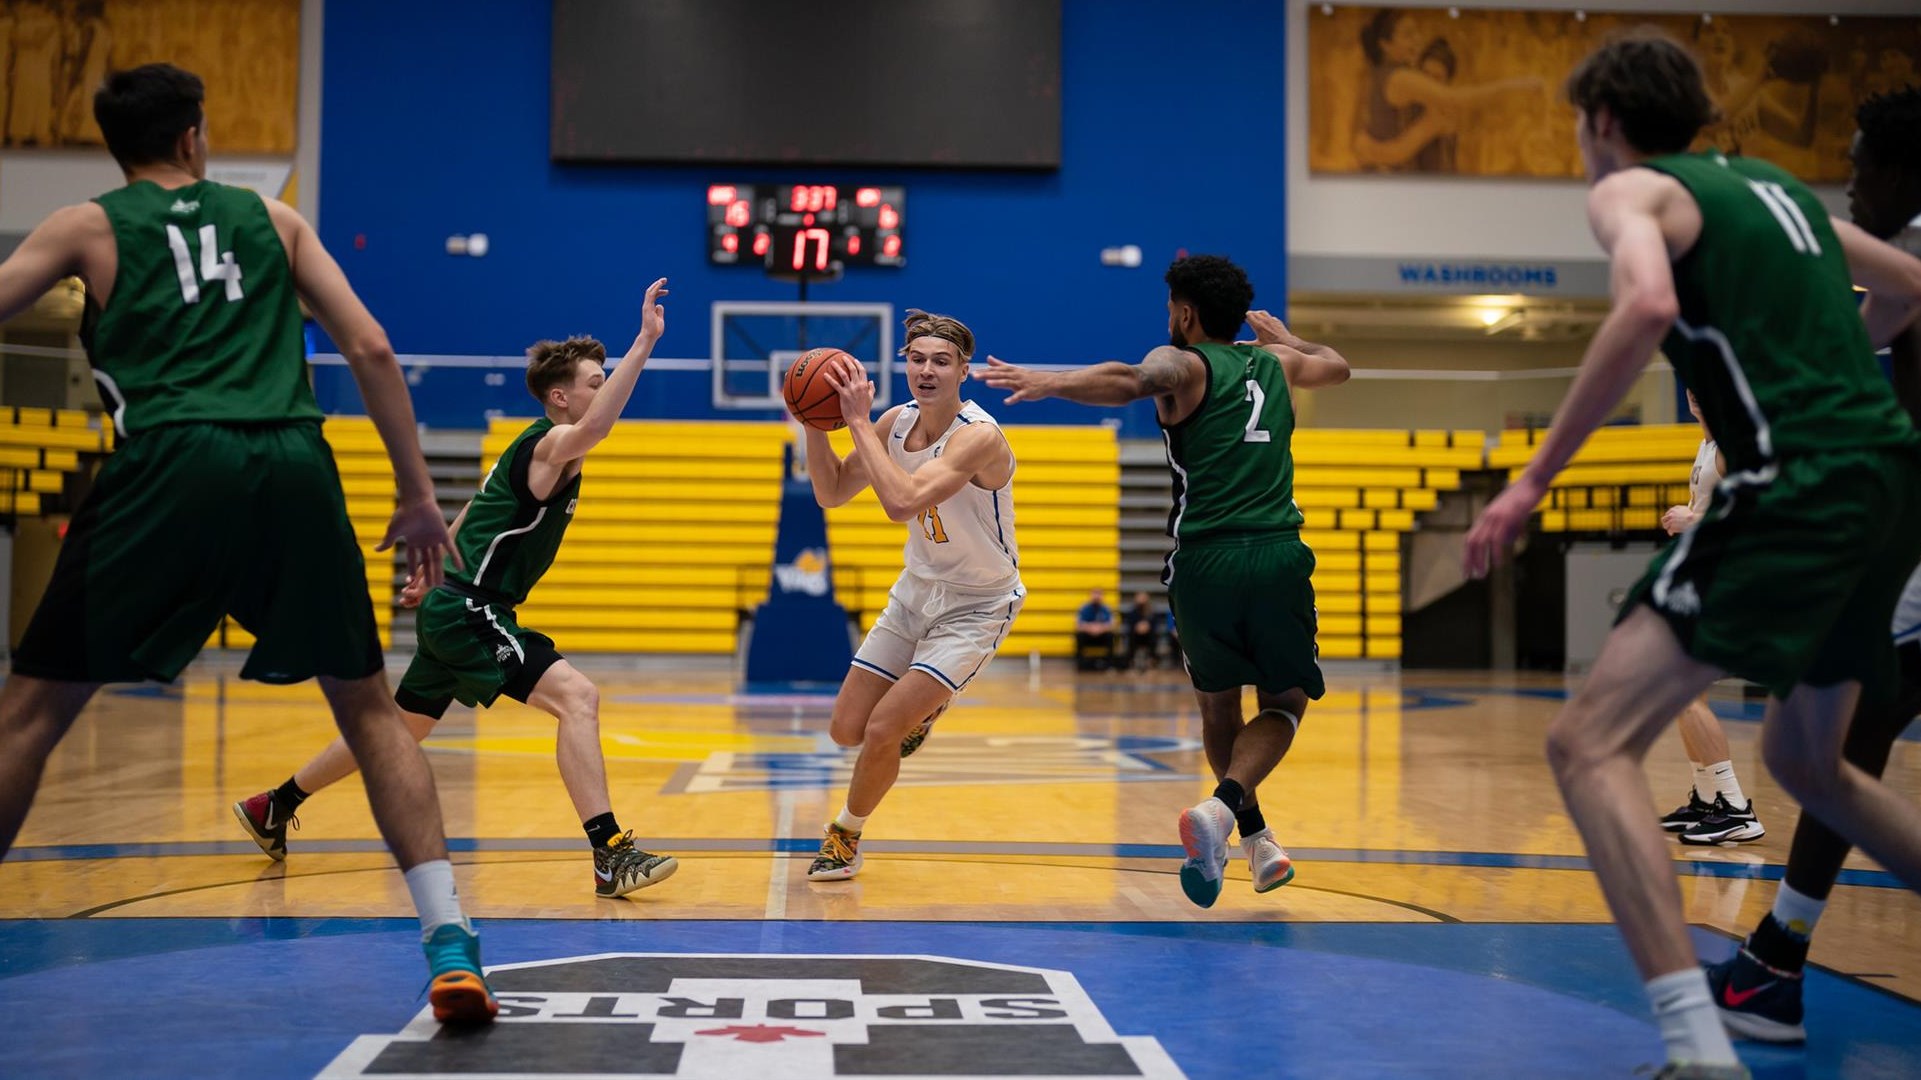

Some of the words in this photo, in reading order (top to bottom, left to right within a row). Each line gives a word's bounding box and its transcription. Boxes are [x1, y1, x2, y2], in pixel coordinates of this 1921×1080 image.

[1747, 180, 1822, 256] 11
[165, 224, 244, 304] 14
[793, 228, 829, 270] 17
[1398, 263, 1557, 287] WASHROOMS
[1243, 379, 1271, 442] 2
[494, 996, 1069, 1019] SPORTS
